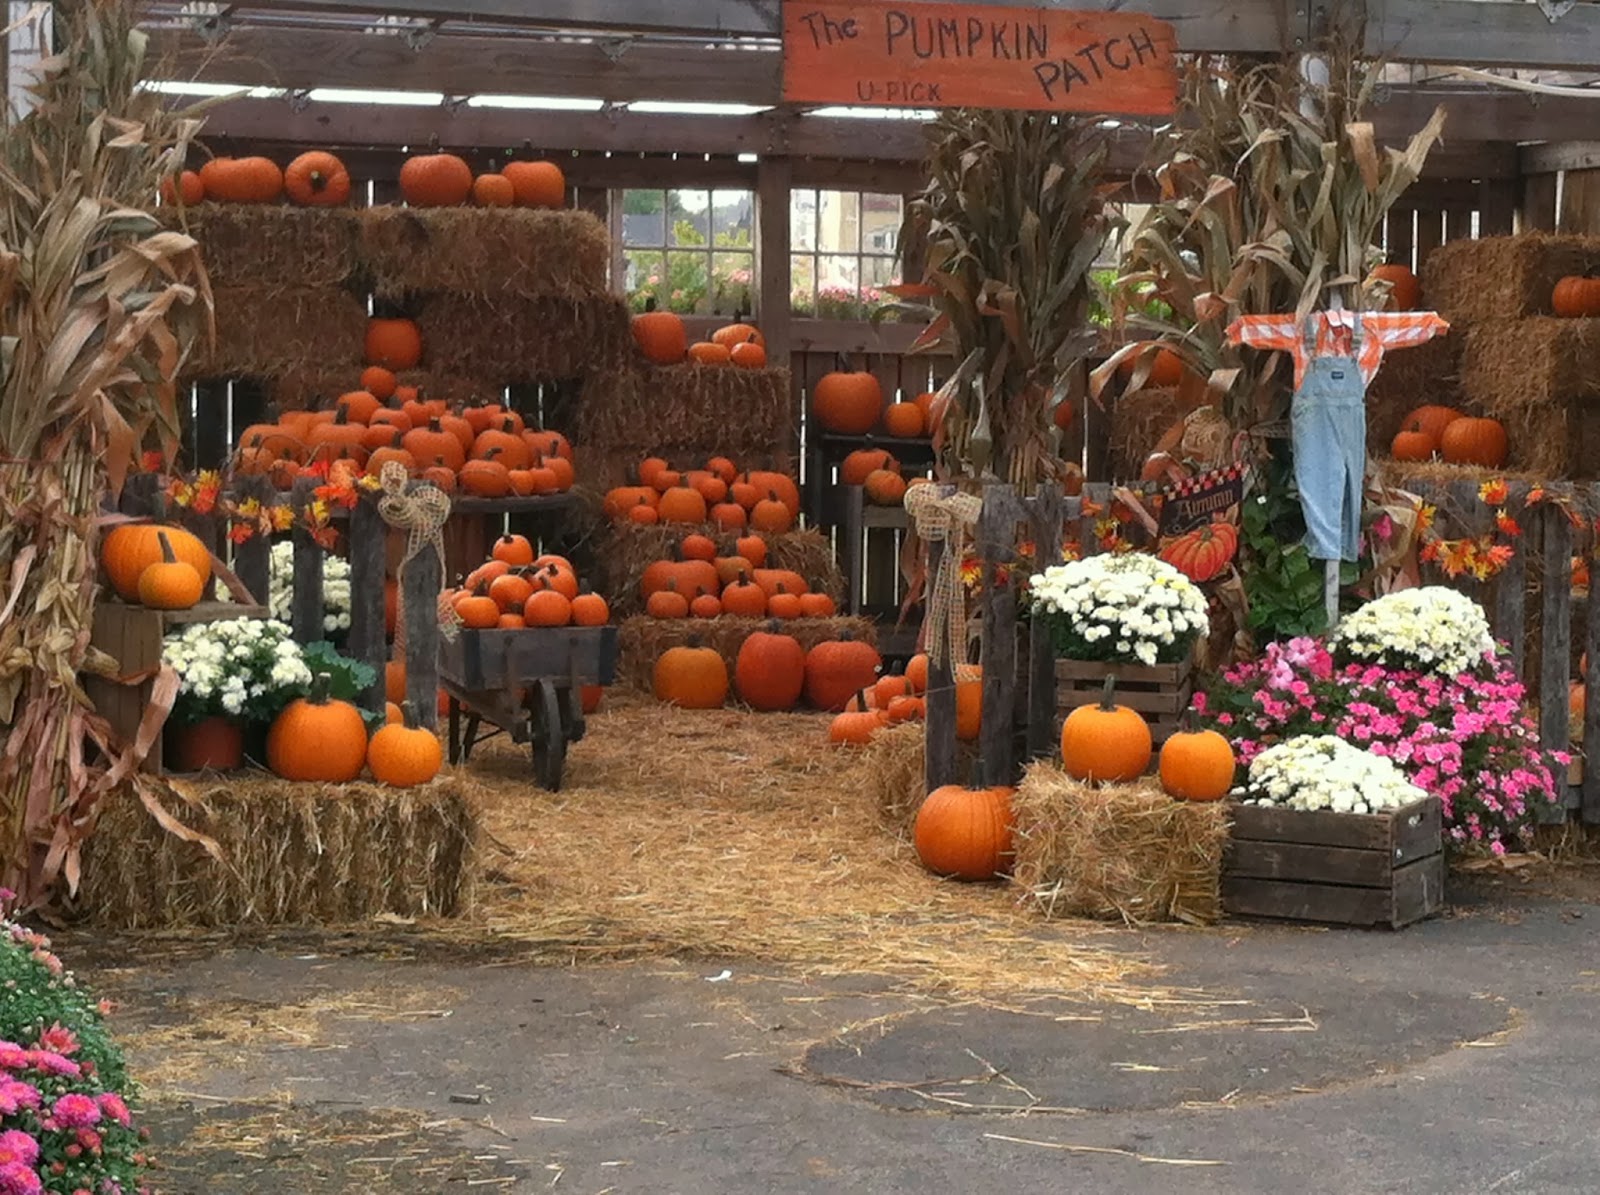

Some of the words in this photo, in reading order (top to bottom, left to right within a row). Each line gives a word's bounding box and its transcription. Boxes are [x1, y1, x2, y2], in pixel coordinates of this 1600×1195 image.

[801, 12, 860, 50] The
[886, 10, 1048, 60] PUMPKIN
[1033, 27, 1158, 101] PATCH
[856, 81, 942, 102] U-PICK
[1179, 489, 1234, 519] Autumn
